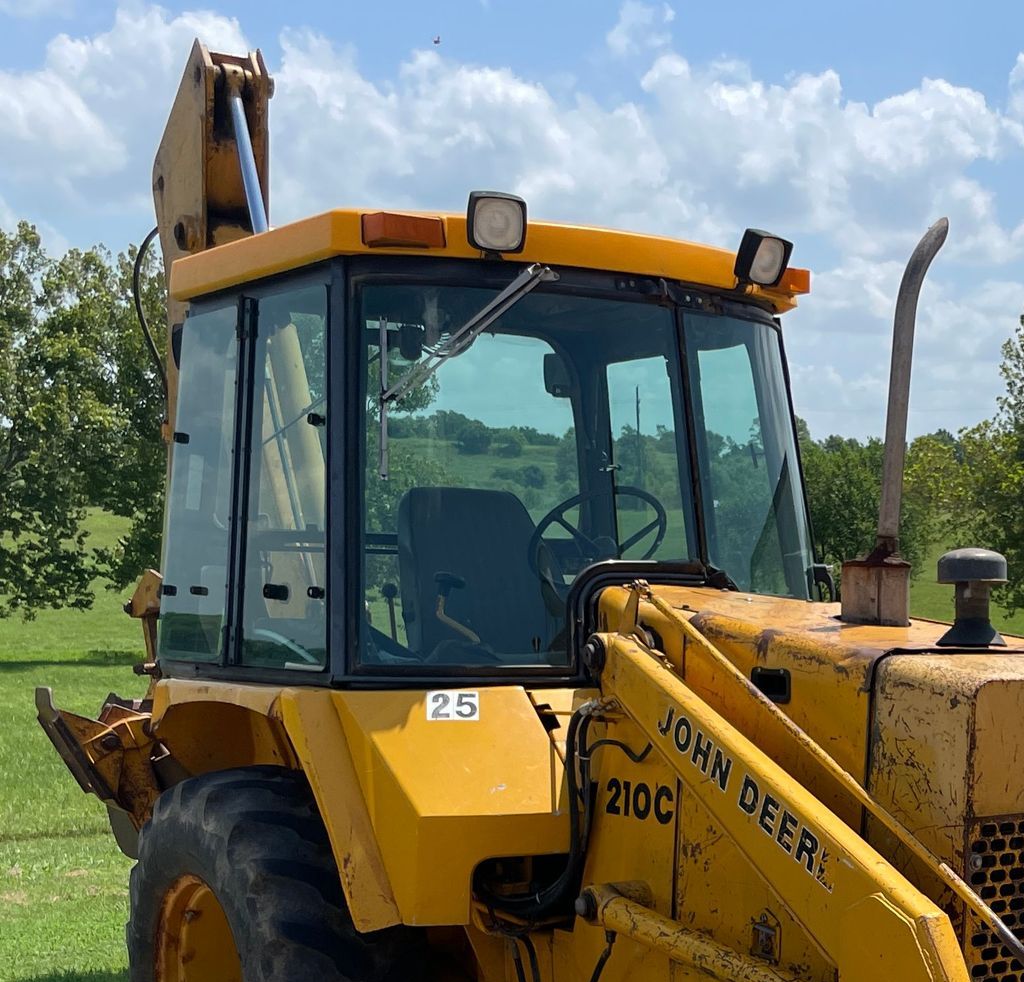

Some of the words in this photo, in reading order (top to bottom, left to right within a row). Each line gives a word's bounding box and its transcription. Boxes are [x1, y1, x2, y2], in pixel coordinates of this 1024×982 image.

[431, 693, 478, 718] 25
[657, 706, 733, 792] JOHN
[605, 777, 675, 825] 210C
